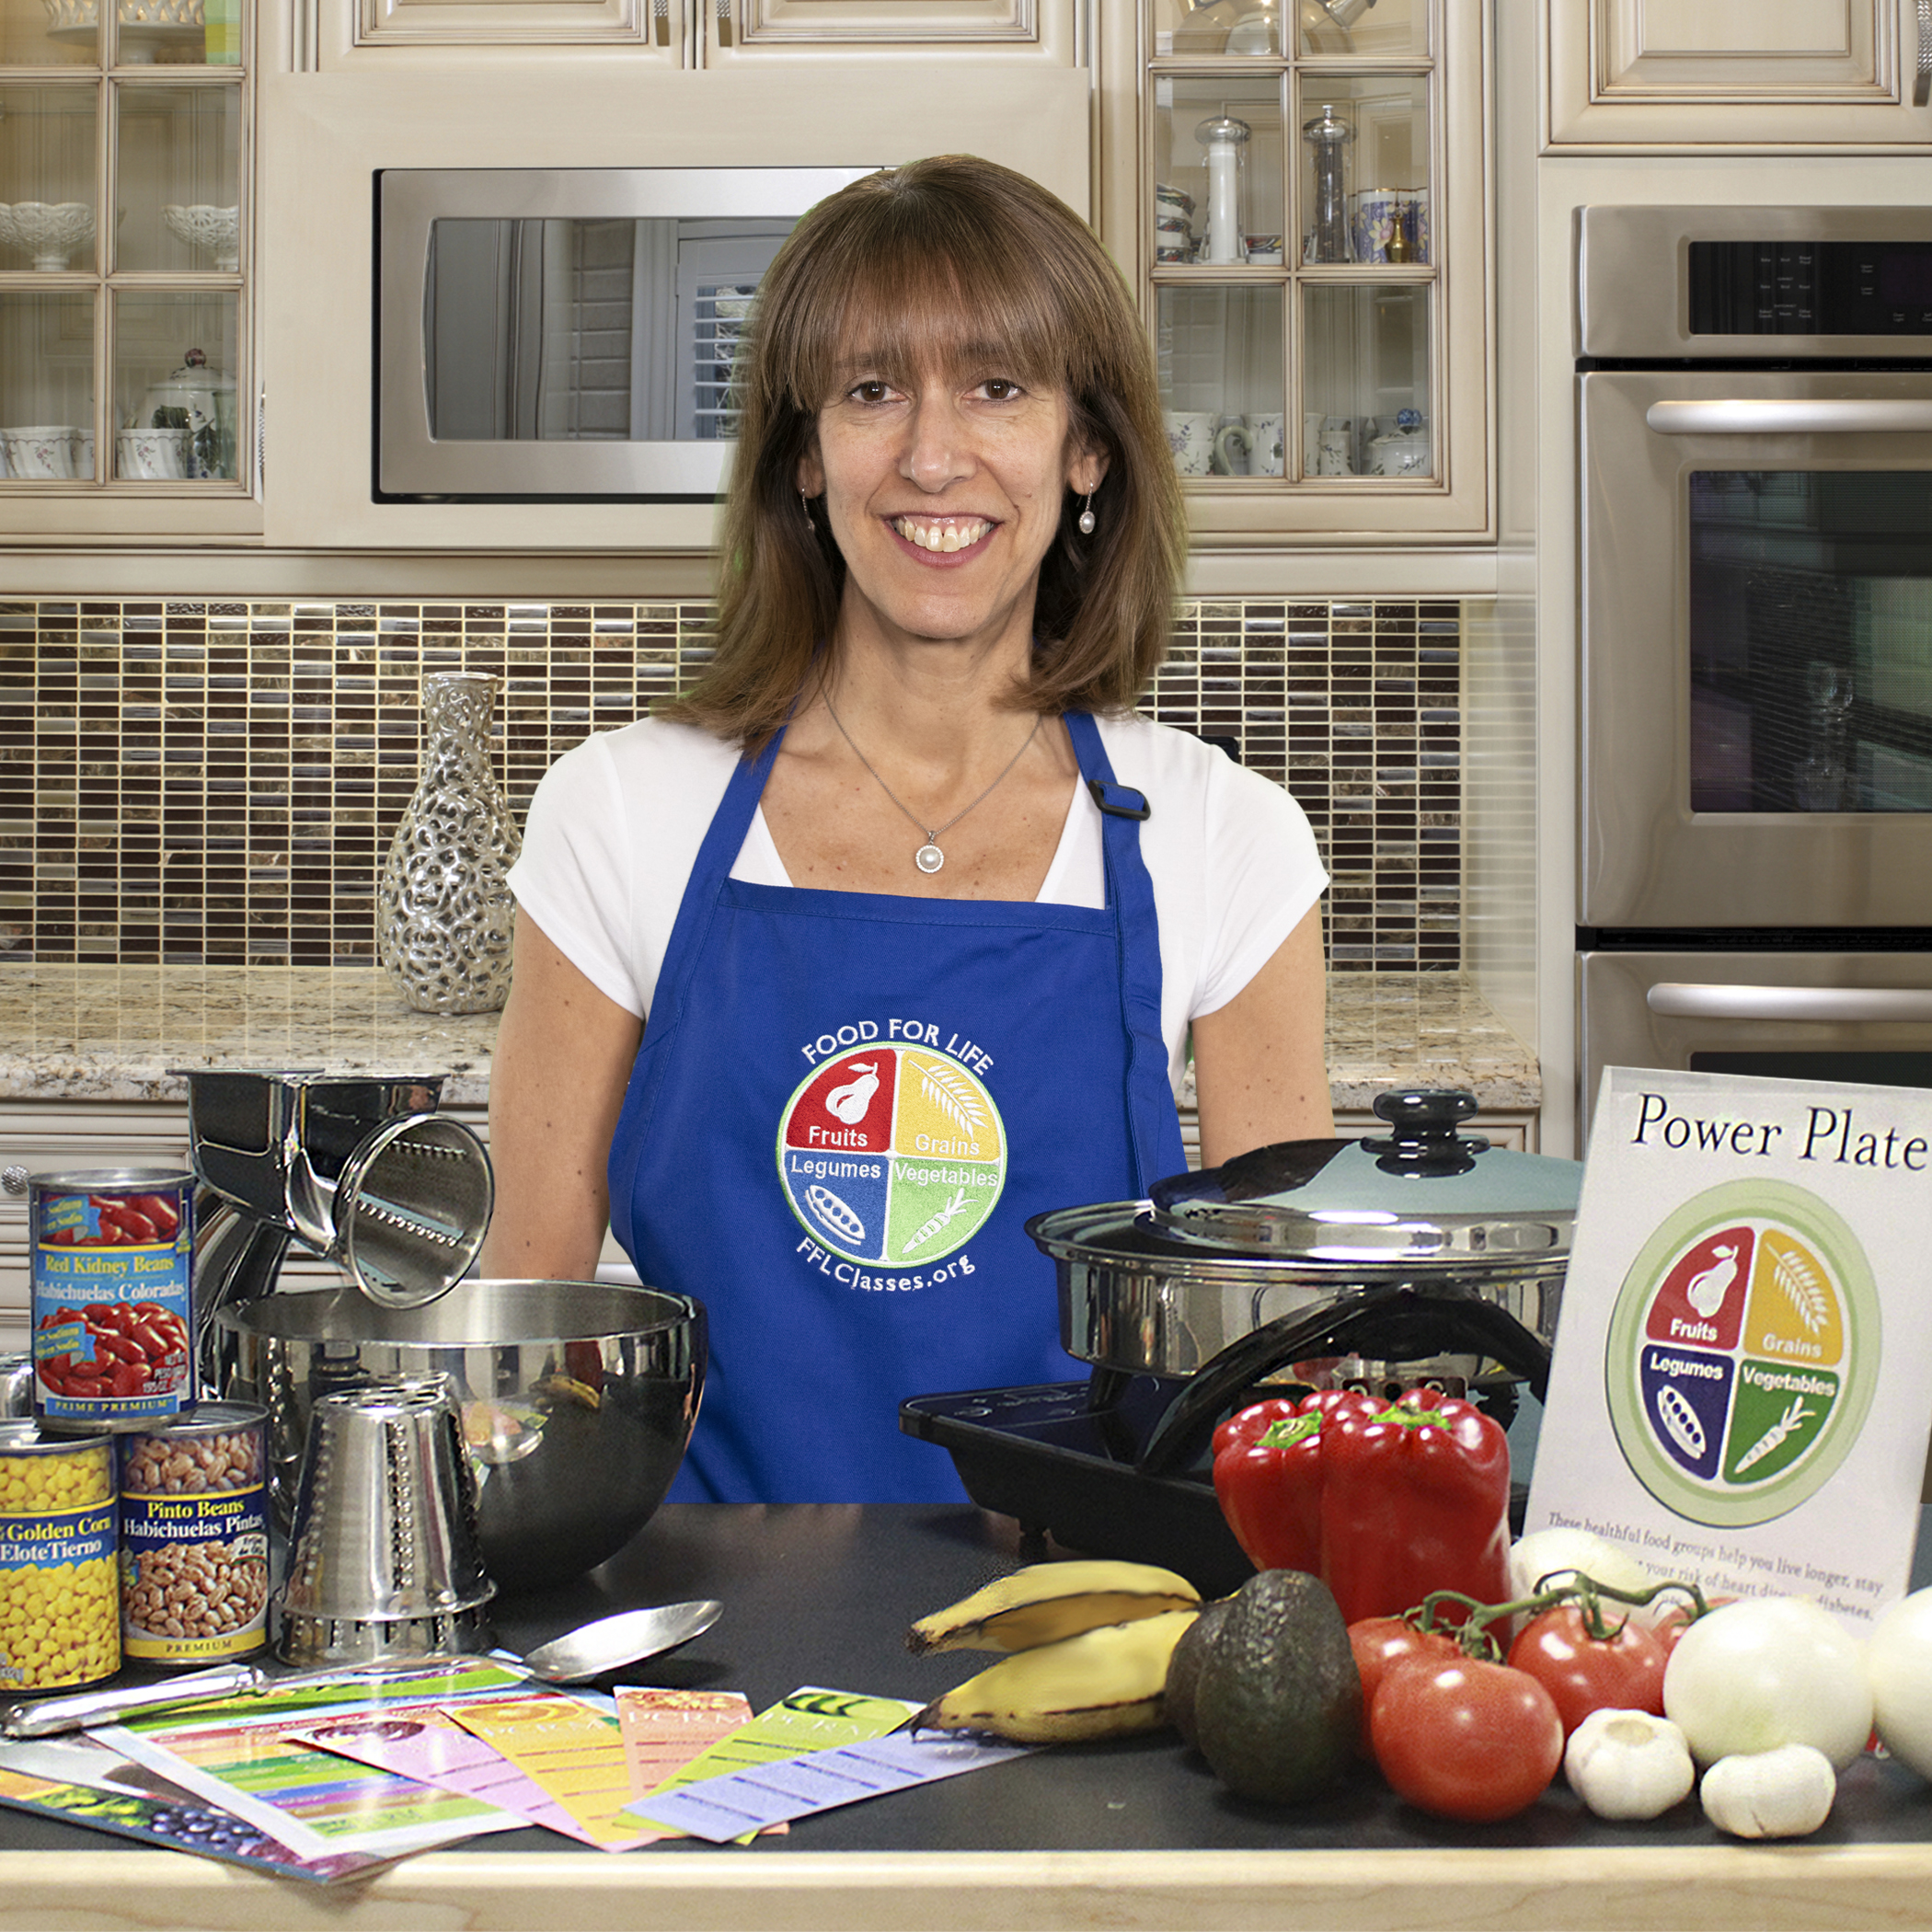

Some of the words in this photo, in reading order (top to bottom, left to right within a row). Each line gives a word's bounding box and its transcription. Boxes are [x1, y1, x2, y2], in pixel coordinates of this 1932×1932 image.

[800, 1019, 879, 1064] FOOD
[889, 1018, 939, 1047] FOR
[944, 1032, 995, 1076] LIFE
[808, 1125, 868, 1148] Fruits
[1630, 1092, 1782, 1156] Power
[1798, 1105, 1929, 1171] Plate
[914, 1133, 980, 1156] Grains
[790, 1155, 881, 1179] Legumes
[894, 1162, 998, 1187] Vegetables
[46, 1254, 69, 1273] Red
[74, 1256, 130, 1278] Kidney
[133, 1255, 175, 1273] Beans
[795, 1236, 976, 1293] FFLClasses.org
[119, 1280, 185, 1301] Coloradas
[1669, 1317, 1719, 1342] Fruits
[1762, 1332, 1823, 1359] Grains
[1650, 1351, 1724, 1380] Legumes
[1742, 1365, 1836, 1397] Vegetables
[55, 1400, 95, 1412] PRIME
[101, 1398, 167, 1412] PREMIUM
[147, 1501, 193, 1519] Pinto
[197, 1500, 245, 1518] Beans
[6, 1523, 75, 1542] Golden
[123, 1517, 223, 1538] Habichuelas
[225, 1513, 264, 1534] Pintas
[0, 1543, 49, 1561] Elote
[46, 1539, 102, 1559] Tierno
[1548, 1512, 1582, 1530] These
[1584, 1518, 1641, 1545] healthful
[1643, 1530, 1672, 1551] food
[1672, 1540, 1715, 1562] groups
[1718, 1545, 1747, 1570] help
[1750, 1554, 1773, 1572] you
[1777, 1557, 1802, 1578] live
[1854, 1578, 1884, 1598] stay
[1646, 1561, 1674, 1576] your
[1679, 1568, 1701, 1584] risk
[1705, 1572, 1720, 1588] of
[1721, 1574, 1756, 1597] heart
[167, 1639, 232, 1652] PREMIUM
